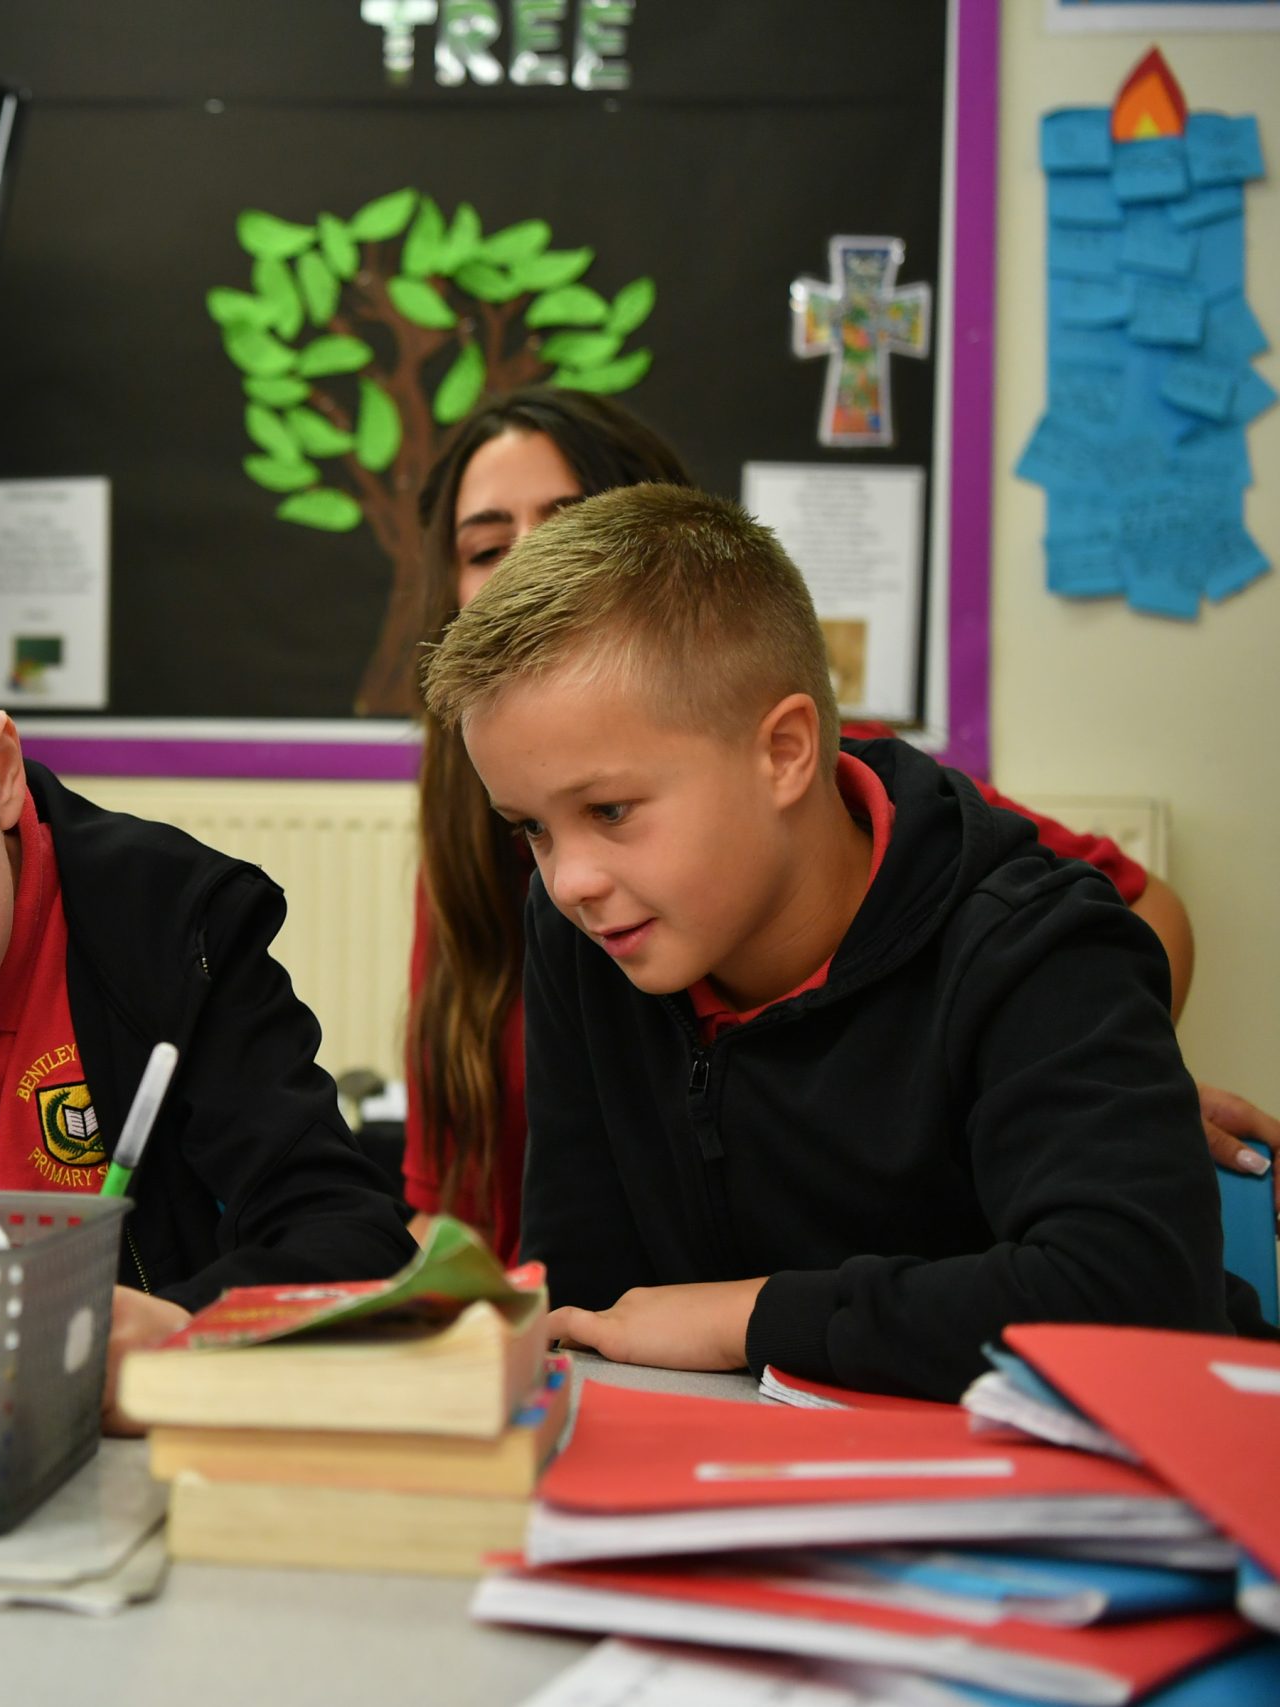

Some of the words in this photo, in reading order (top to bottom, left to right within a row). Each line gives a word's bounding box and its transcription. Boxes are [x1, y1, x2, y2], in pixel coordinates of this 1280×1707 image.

[361, 0, 634, 89] TREE
[16, 1043, 77, 1103] BENTLEY
[27, 1146, 92, 1188] PRIMARY
